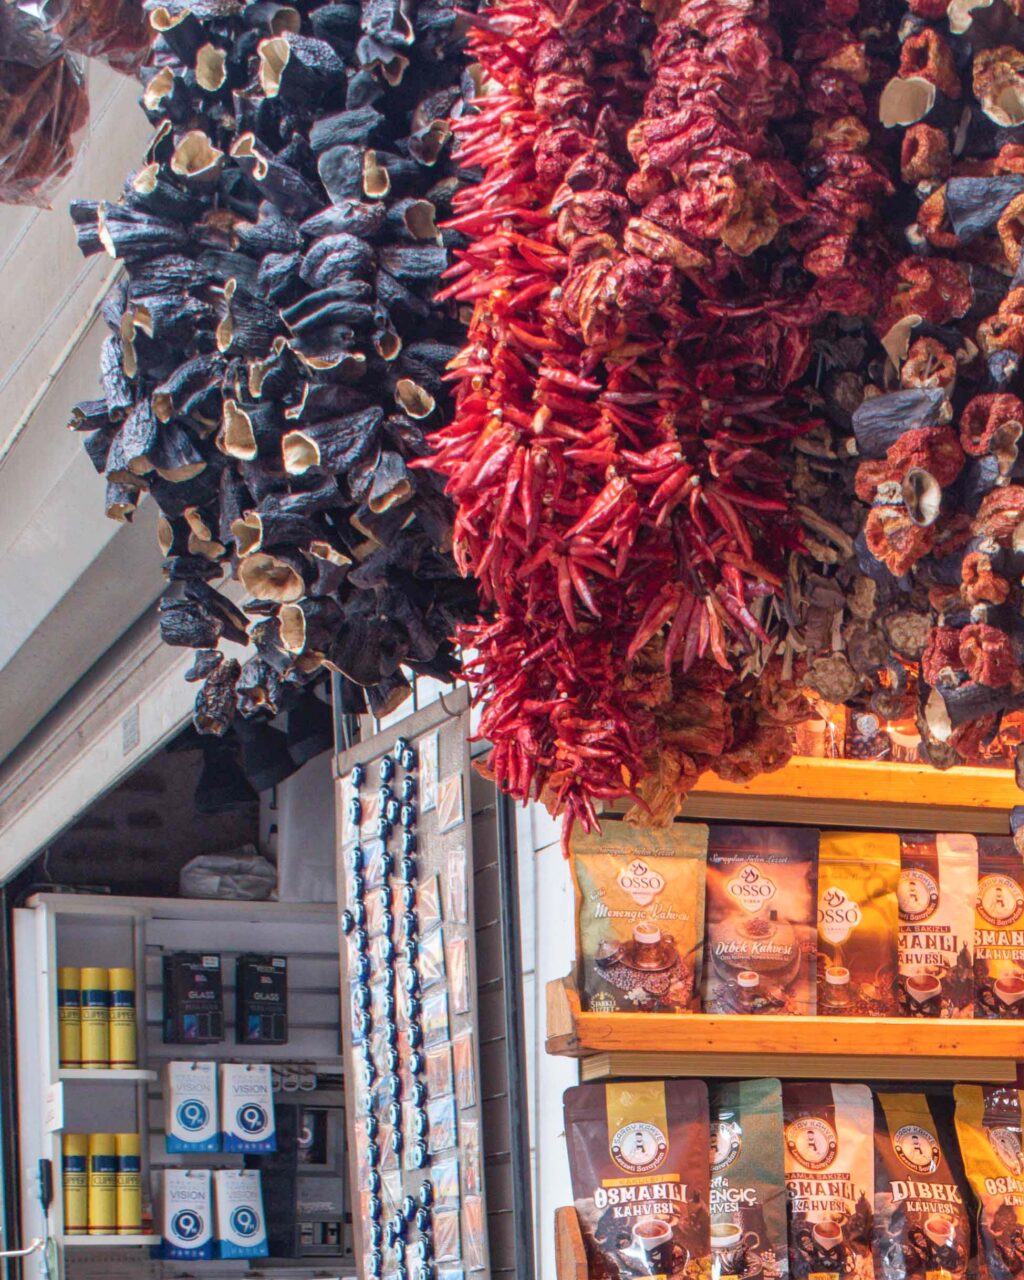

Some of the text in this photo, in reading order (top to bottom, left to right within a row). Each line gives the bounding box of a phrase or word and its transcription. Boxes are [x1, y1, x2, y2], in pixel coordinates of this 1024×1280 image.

[620, 876, 661, 889] OSSO
[731, 885, 771, 897] OSSO
[899, 935, 957, 952] MANLI
[232, 1085, 267, 1093] VISION
[170, 1190, 205, 1200] VISION
[594, 1184, 688, 1209] OSMANLI
[788, 1180, 855, 1202] SMANLI
[889, 1176, 962, 1205] DİBEK
